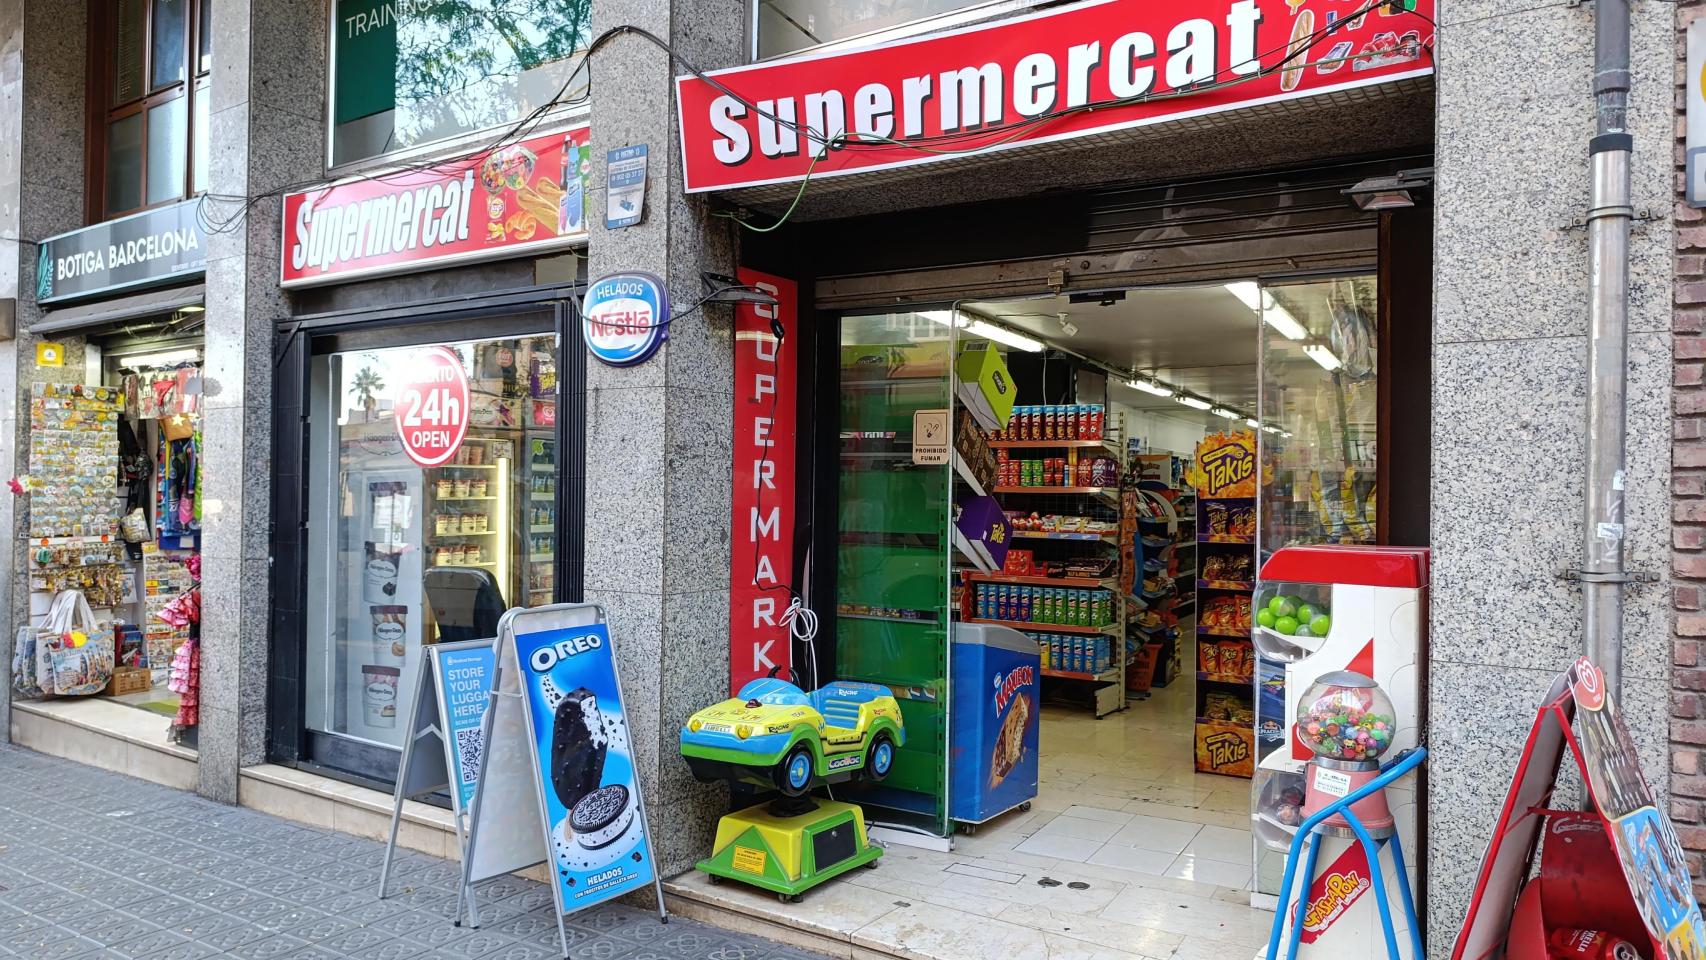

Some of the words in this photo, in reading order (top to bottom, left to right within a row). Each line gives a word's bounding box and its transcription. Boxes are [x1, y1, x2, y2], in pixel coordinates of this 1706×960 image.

[708, 0, 1262, 167] Supermercat
[292, 169, 475, 273] Supermercat
[57, 248, 105, 280] BOTIGA
[108, 228, 199, 269] BARCELONA
[596, 283, 643, 300] HELADOS
[590, 310, 651, 338] Nestlé
[402, 387, 459, 427] 24h
[411, 430, 450, 448] OPEN
[1205, 454, 1253, 494] Takis
[530, 633, 602, 674] OREO
[448, 666, 485, 680] STORE
[450, 679, 481, 693] YOUR
[452, 690, 490, 705] LUGGA
[454, 703, 484, 717] HERE
[1209, 743, 1247, 769] Takis
[587, 867, 622, 886] HELADOS
